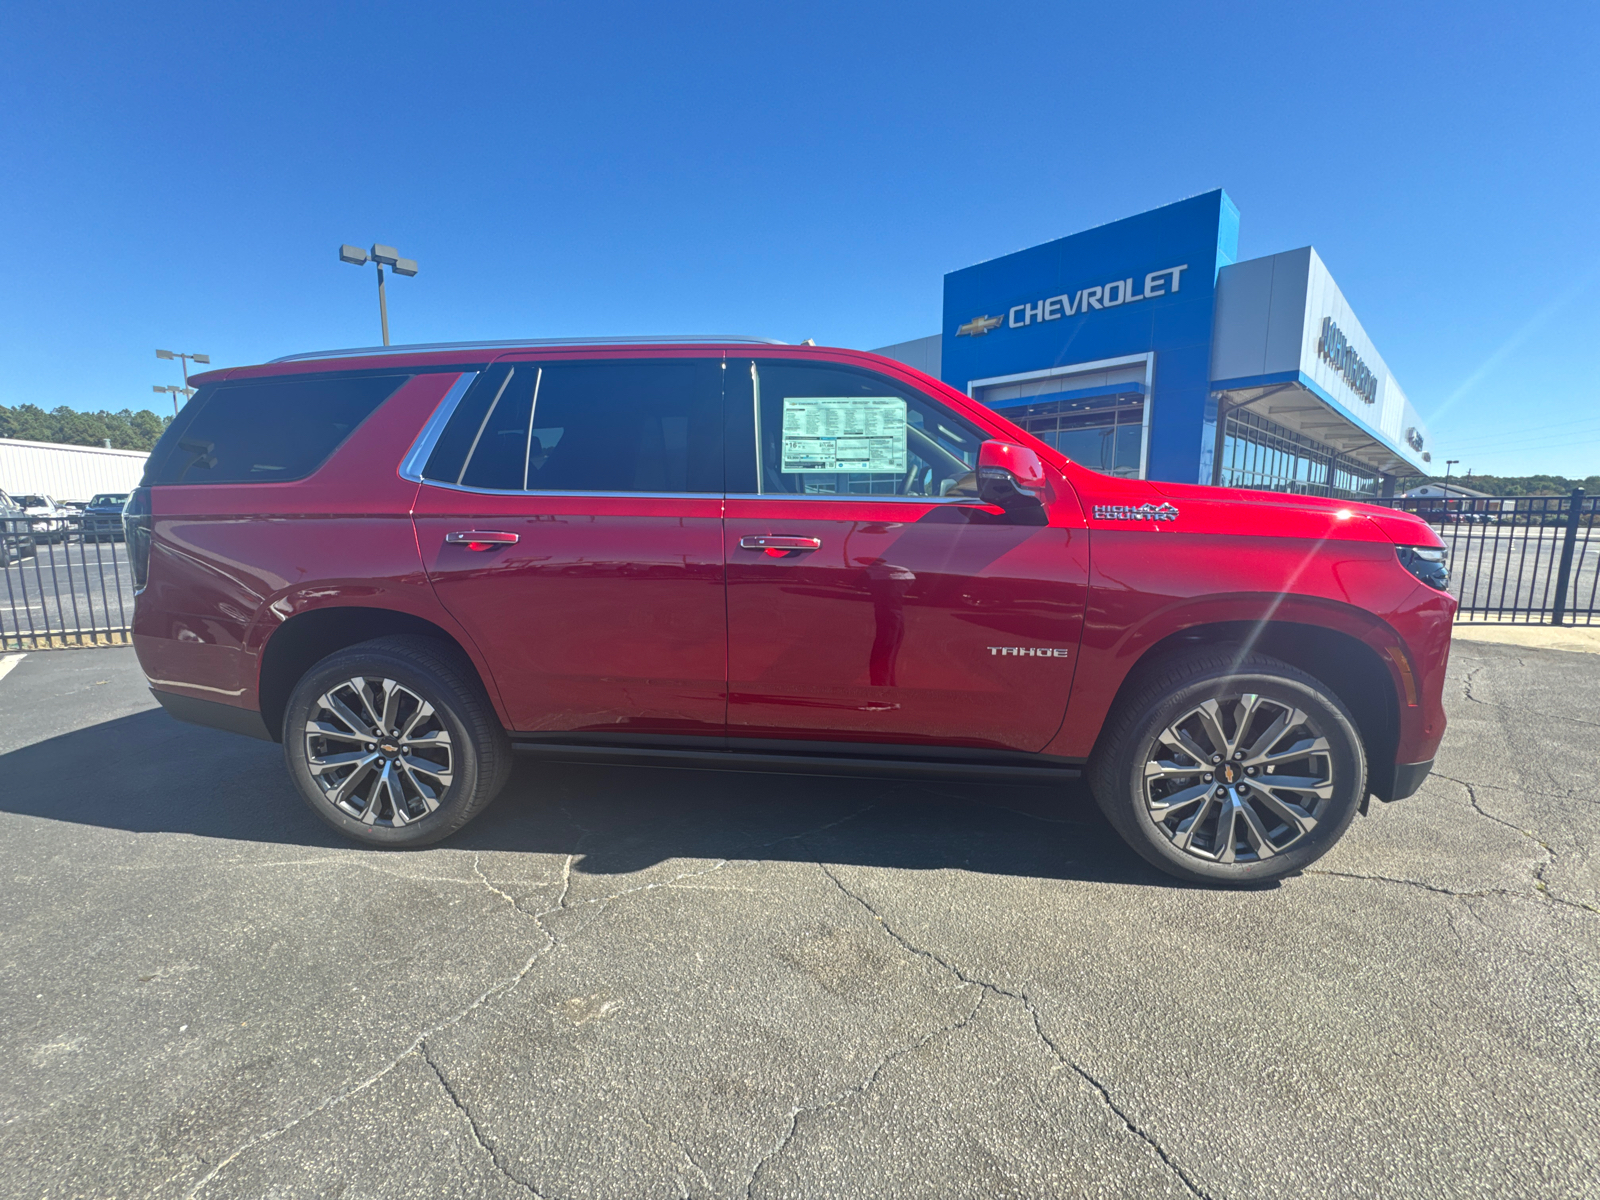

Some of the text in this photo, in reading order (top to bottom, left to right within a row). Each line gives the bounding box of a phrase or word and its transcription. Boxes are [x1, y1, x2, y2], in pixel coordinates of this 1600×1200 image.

[1008, 264, 1188, 328] CHEVROLET
[1093, 505, 1137, 513] HIGH
[1093, 512, 1178, 522] COUNTRY
[987, 646, 1068, 658] TAHOE
